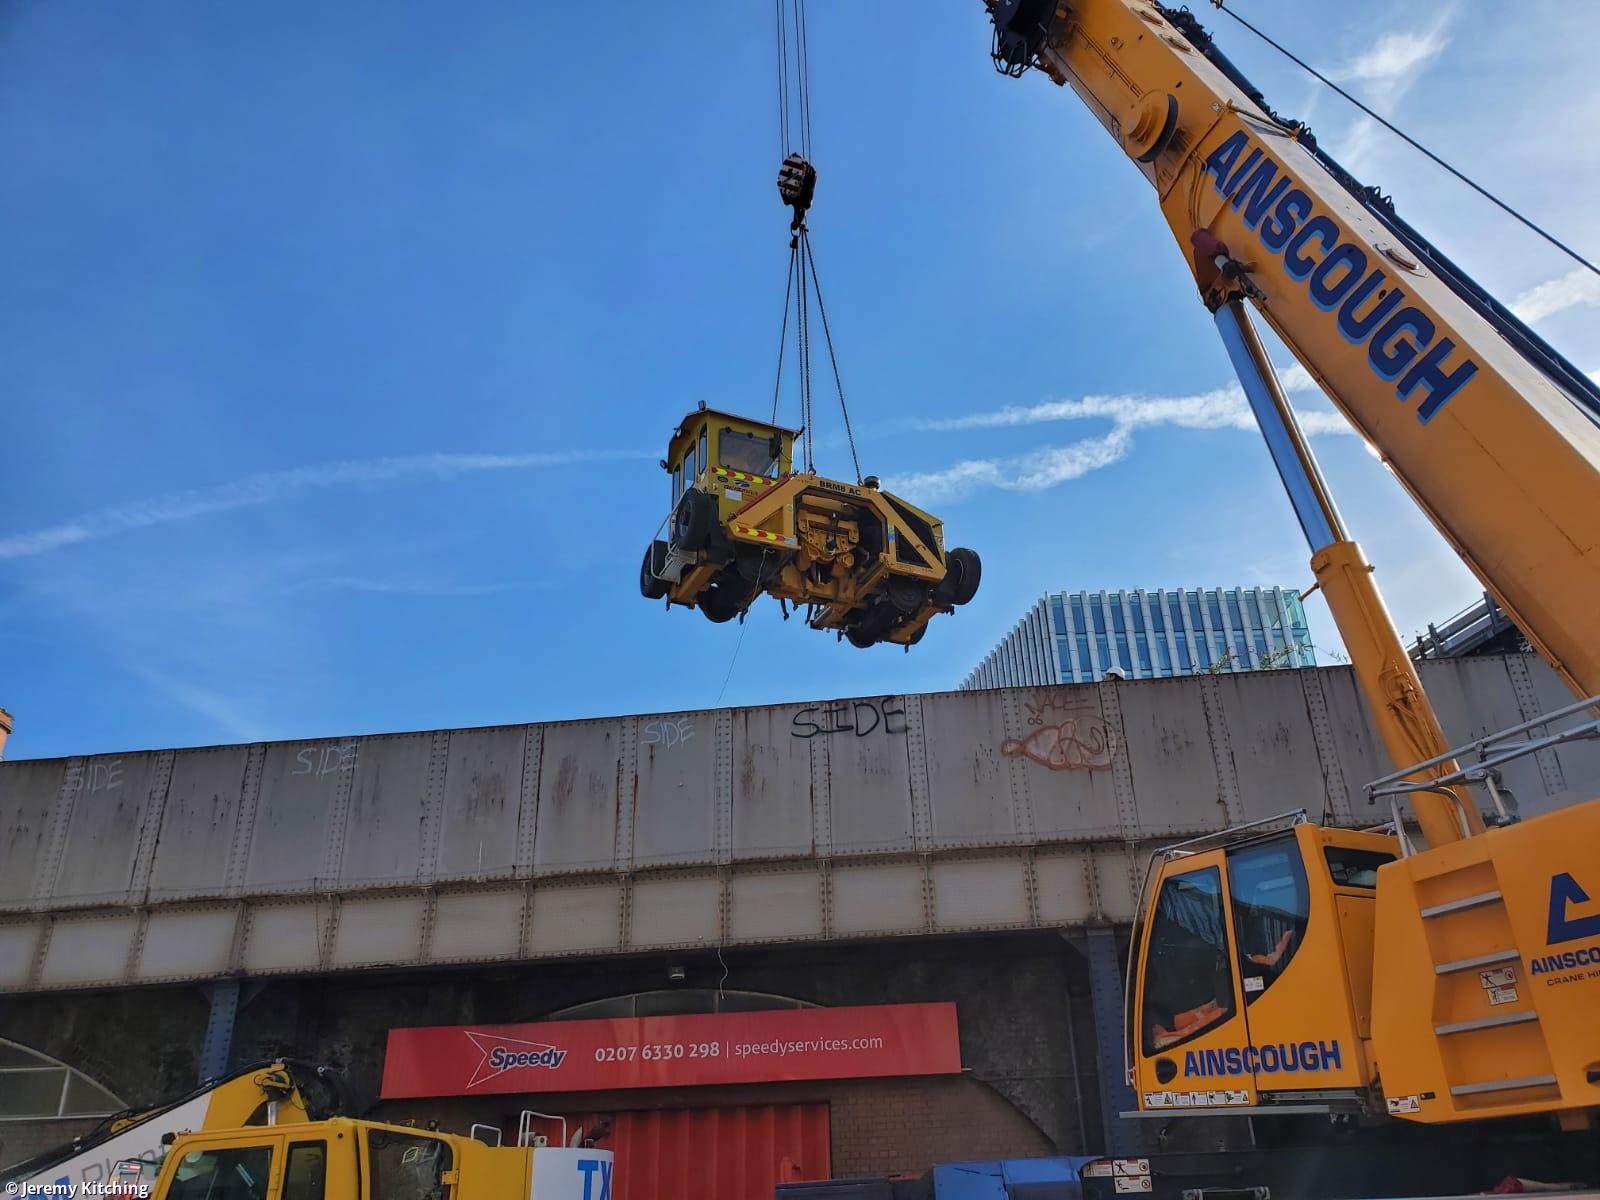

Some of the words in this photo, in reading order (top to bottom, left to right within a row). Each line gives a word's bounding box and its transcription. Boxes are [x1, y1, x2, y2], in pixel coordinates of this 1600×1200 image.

[1206, 129, 1479, 426] AINSCOUGH
[849, 487, 861, 496] AC
[791, 695, 911, 738] SIDE
[641, 717, 695, 752] SIDE
[62, 759, 124, 792] SIDE
[291, 744, 360, 781] SIDE
[1546, 973, 1585, 987] CRANE
[489, 1046, 567, 1070] Speedy
[594, 1046, 637, 1062] 0207
[641, 1044, 684, 1060] 6330
[688, 1042, 720, 1058] 298
[734, 1035, 883, 1058] speedyservices.com
[1183, 1040, 1342, 1078] AINSCOUGH
